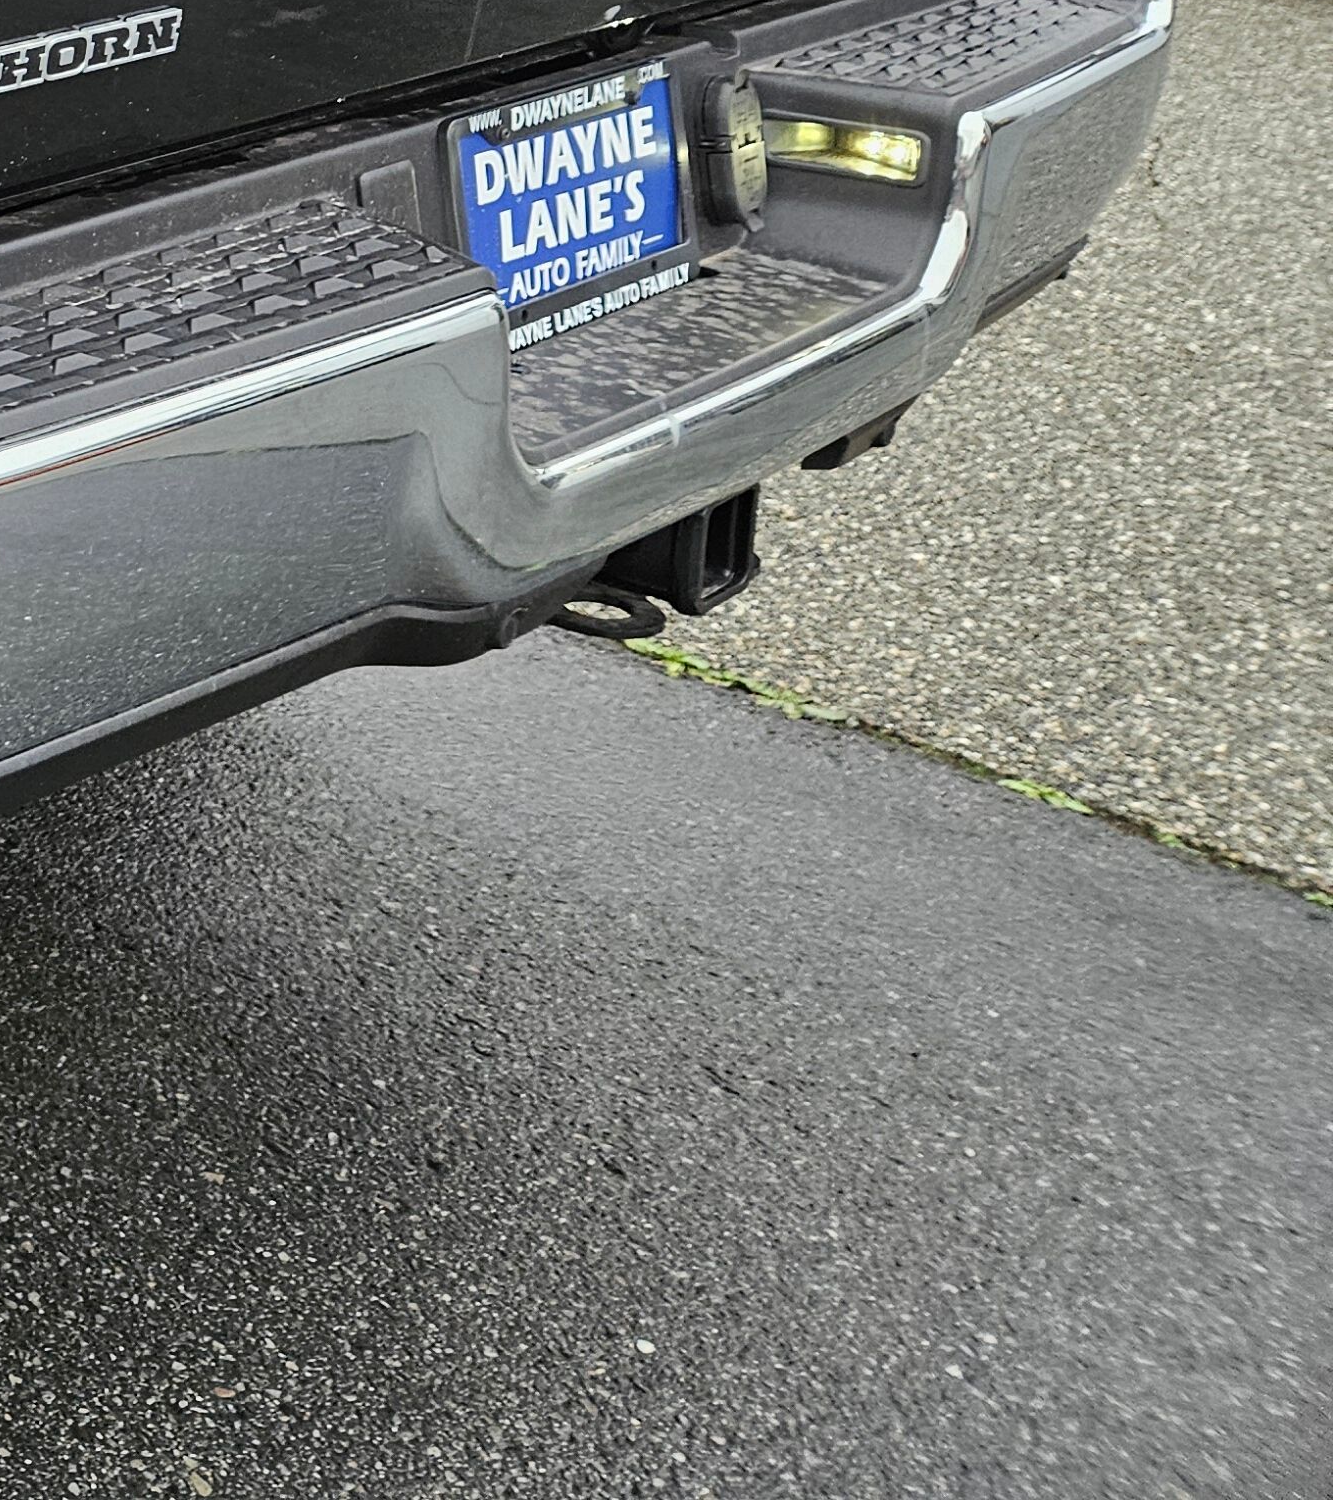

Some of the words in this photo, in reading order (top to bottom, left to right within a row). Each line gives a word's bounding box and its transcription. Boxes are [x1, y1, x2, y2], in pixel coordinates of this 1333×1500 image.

[510, 75, 626, 132] DWAYNELANE
[473, 105, 657, 206] DWAYNE
[499, 170, 645, 263] LANE'S
[509, 257, 571, 304] AUTO
[575, 231, 644, 280] FAMILY
[604, 282, 641, 315] AUTO
[639, 262, 690, 299] FAMILY
